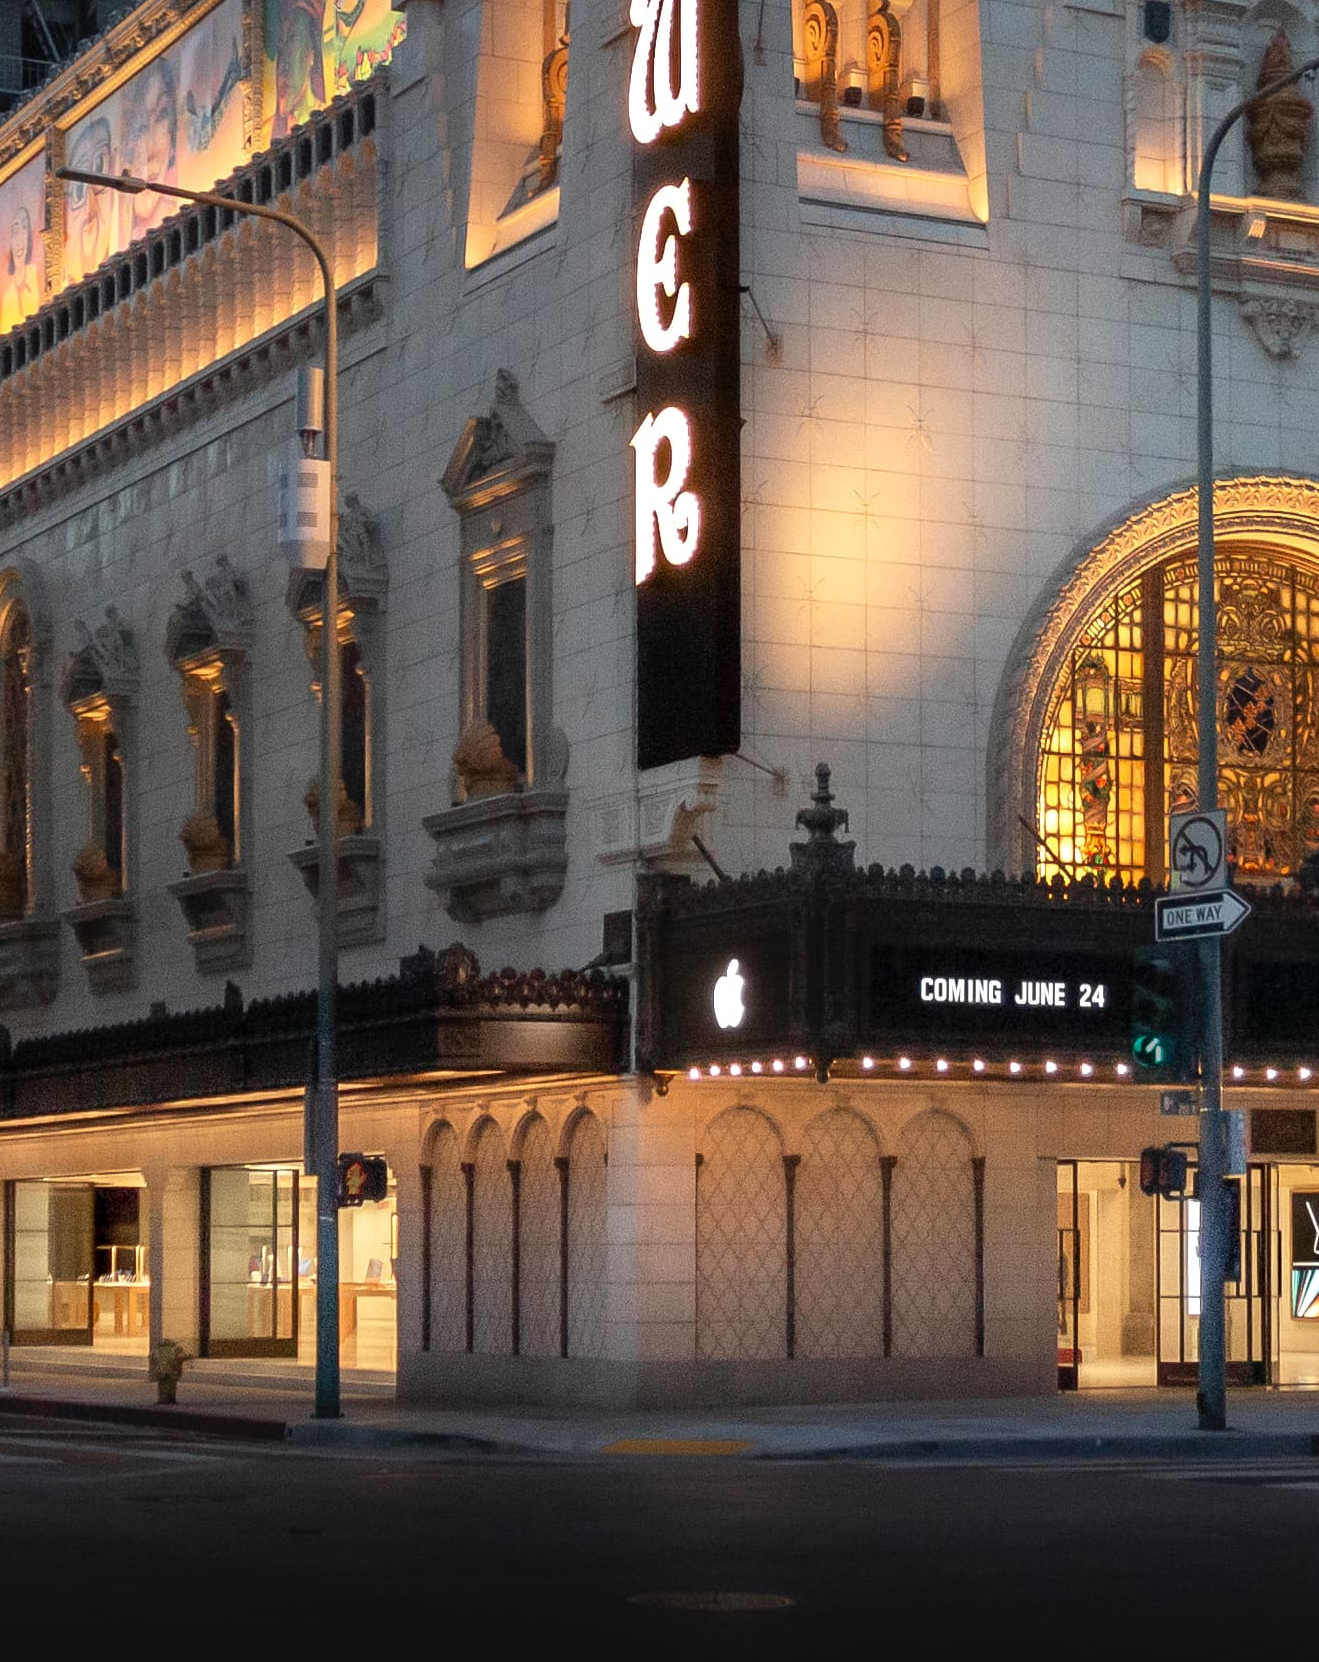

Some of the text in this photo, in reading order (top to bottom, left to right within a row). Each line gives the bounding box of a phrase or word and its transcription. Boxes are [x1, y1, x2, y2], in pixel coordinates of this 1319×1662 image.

[1167, 905, 1223, 926] ONE WAY
[920, 977, 1105, 1007] COMING JUNE 24
